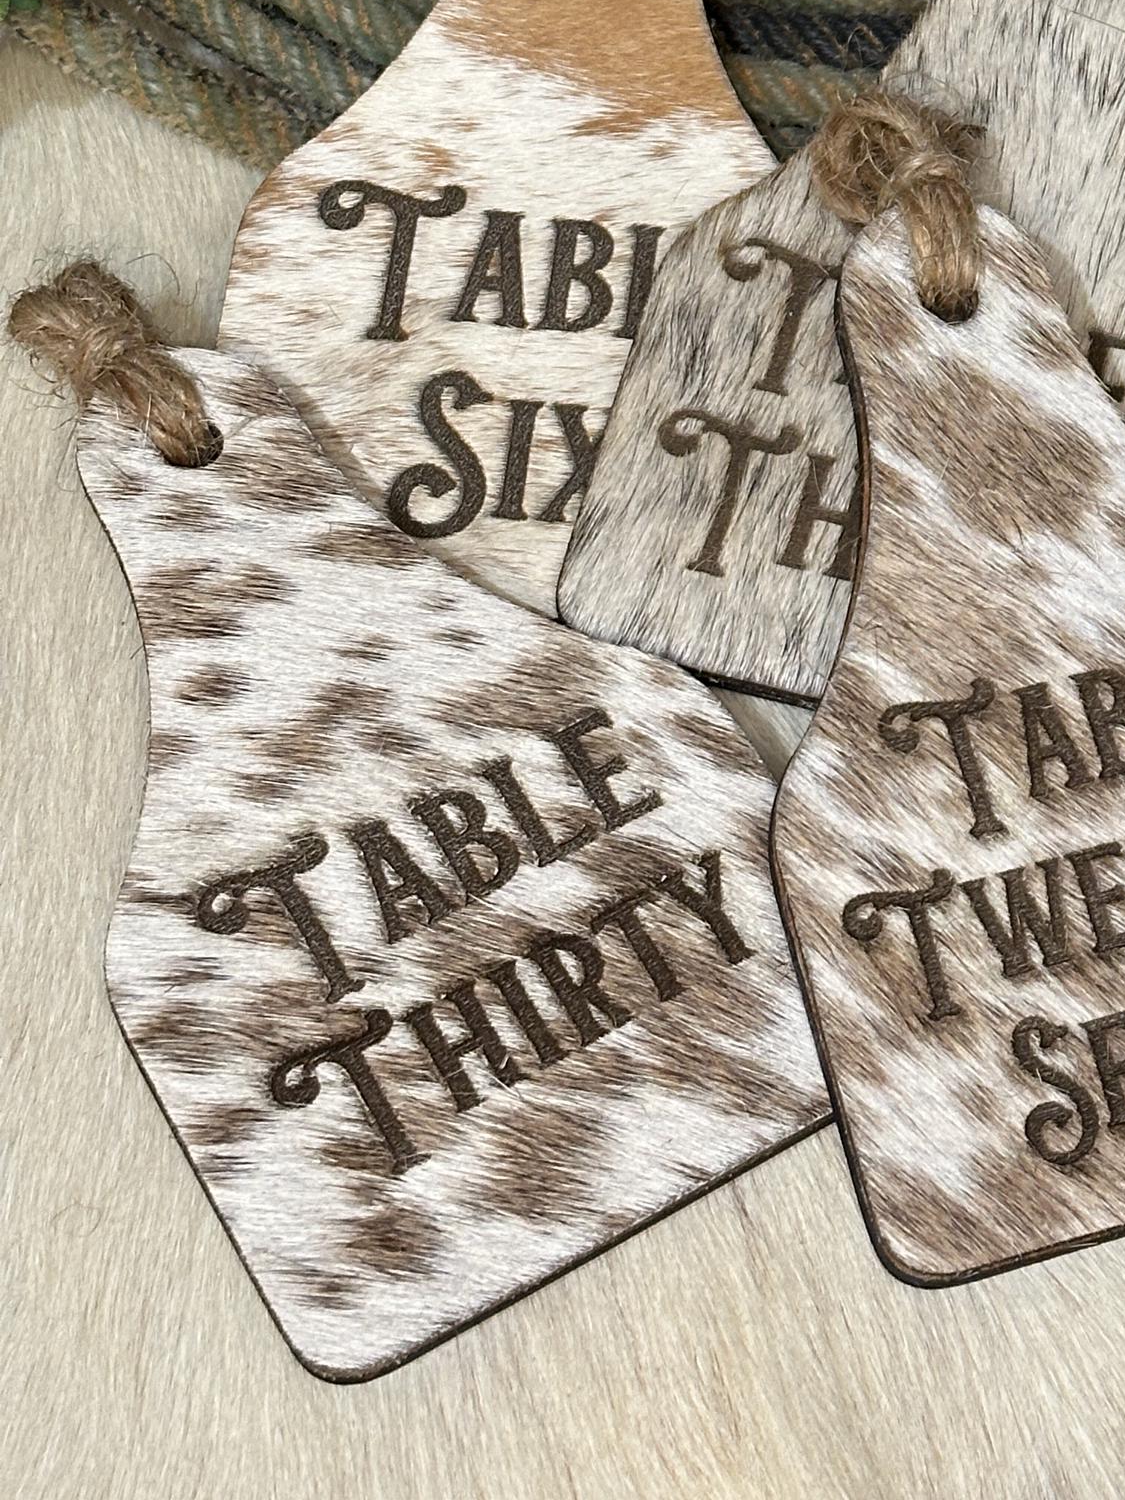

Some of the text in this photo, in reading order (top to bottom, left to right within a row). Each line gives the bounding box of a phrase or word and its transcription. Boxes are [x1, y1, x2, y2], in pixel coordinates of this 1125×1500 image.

[317, 179, 667, 341] TABL
[195, 706, 664, 1002] TABLE
[268, 849, 753, 1175] THIRTY
